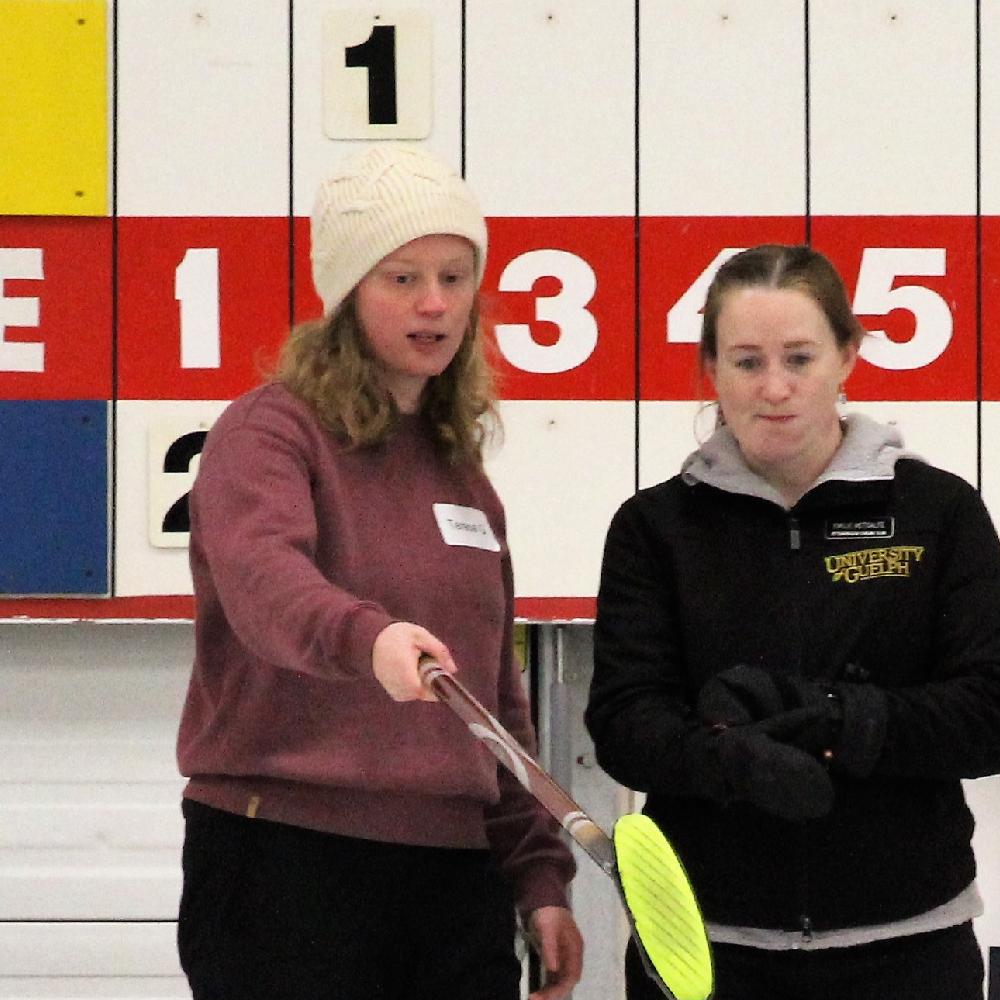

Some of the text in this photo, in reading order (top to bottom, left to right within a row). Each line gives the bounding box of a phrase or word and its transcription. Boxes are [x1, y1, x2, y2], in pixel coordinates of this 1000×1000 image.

[346, 25, 397, 125] 1
[175, 247, 221, 369] 1
[494, 248, 599, 374] 3
[852, 247, 953, 370] 5
[824, 546, 925, 574] UNIVERSITY
[844, 562, 910, 584] GUELPH
